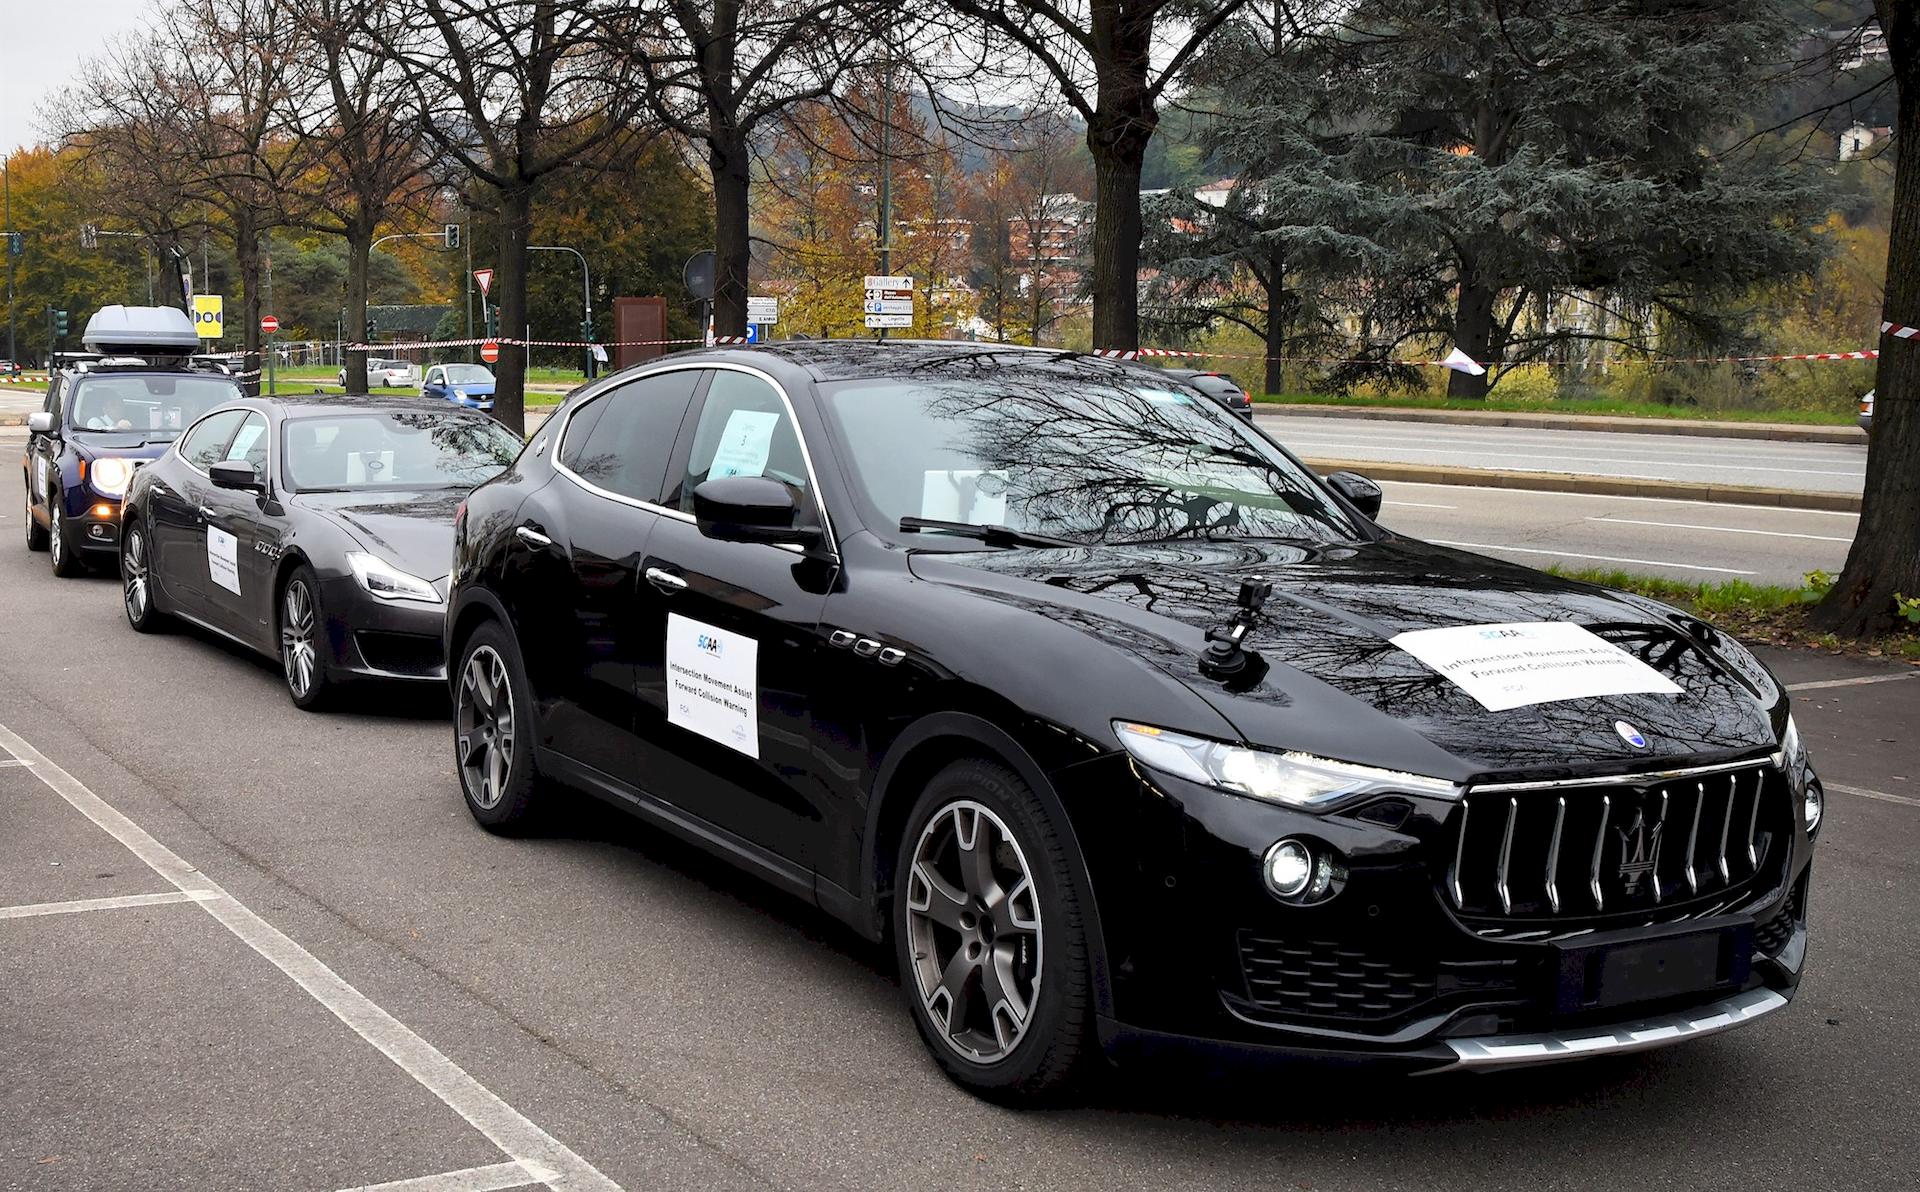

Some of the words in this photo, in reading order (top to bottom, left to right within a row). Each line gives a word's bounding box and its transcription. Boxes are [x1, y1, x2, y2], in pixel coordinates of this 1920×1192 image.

[1442, 654, 1523, 671] Intersection
[1523, 648, 1588, 658] Movement
[1470, 664, 1527, 678] Forward
[1527, 660, 1582, 671] Collision
[670, 660, 702, 681] Intersection
[703, 673, 733, 693] Movement
[734, 685, 753, 700] Assist
[675, 679, 697, 695] Forward
[698, 688, 722, 705] Collision
[724, 699, 748, 718] Warning
